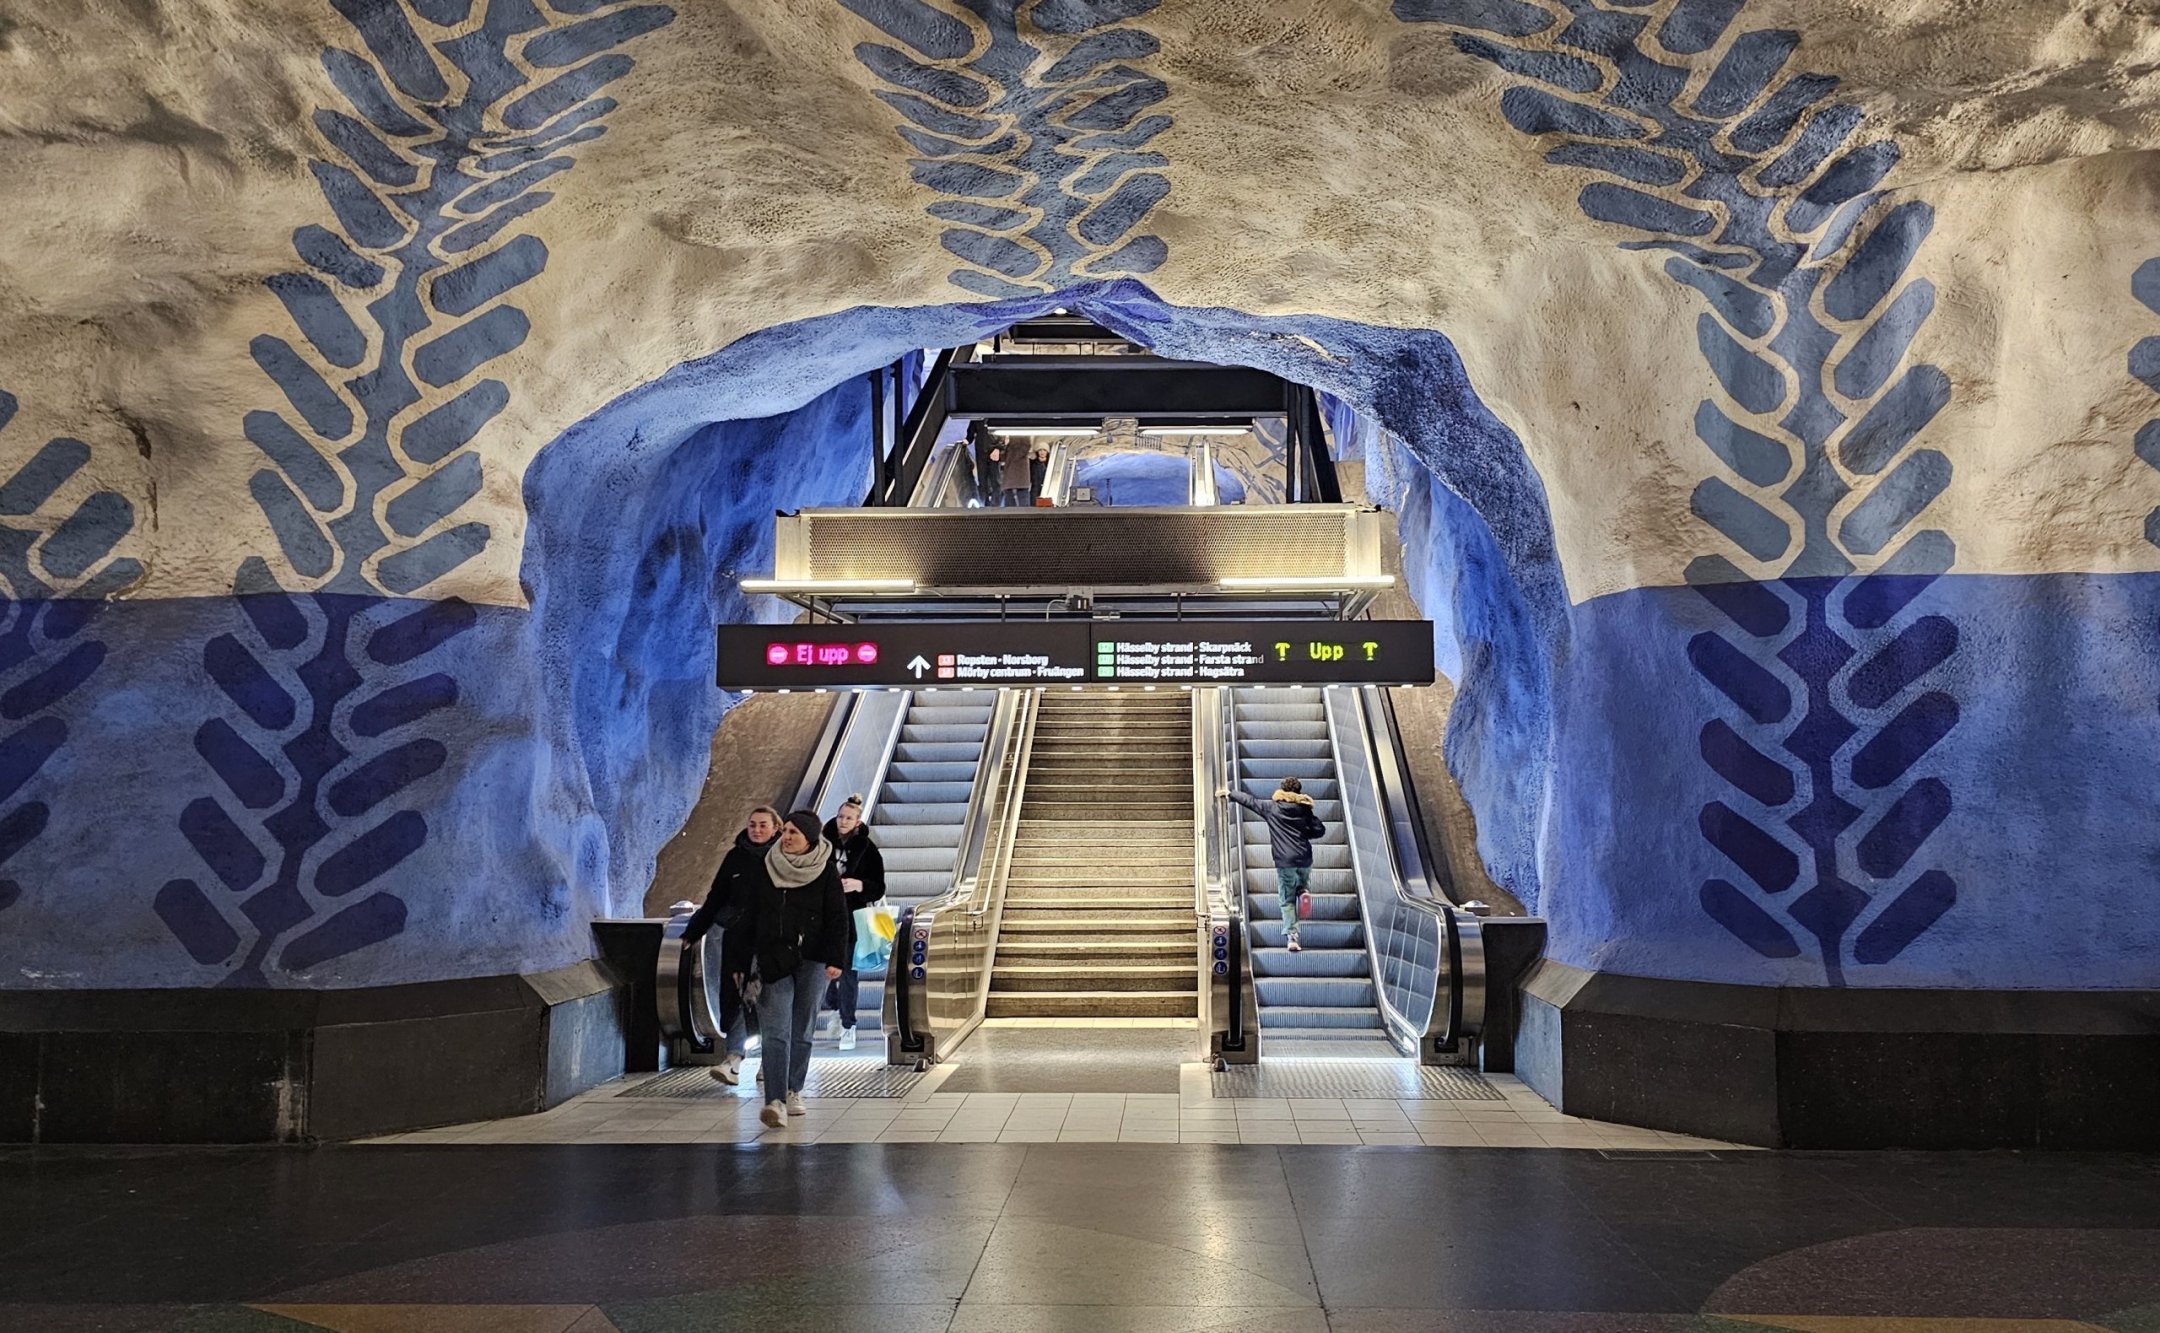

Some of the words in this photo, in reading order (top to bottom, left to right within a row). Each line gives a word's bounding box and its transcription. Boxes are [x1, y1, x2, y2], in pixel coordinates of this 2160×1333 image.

[797, 644, 813, 665] Ej
[819, 647, 849, 665] upp
[1116, 642, 1160, 654] Hässelby
[1161, 642, 1193, 653] strand
[1199, 642, 1252, 654] Skarpnäck
[1309, 642, 1344, 661] Upp
[956, 654, 997, 666] Ropsten
[1002, 654, 1049, 667] Norsborg
[1116, 654, 1160, 666] Hässelby
[1161, 654, 1193, 665] strand
[1199, 654, 1232, 665] Farsta
[1232, 654, 1264, 665] strand
[956, 666, 990, 679] Mörby
[990, 667, 1031, 678] centrum
[1116, 666, 1160, 678] Hässelby
[1161, 666, 1193, 677] strand
[1199, 666, 1245, 678] Hagsätra
